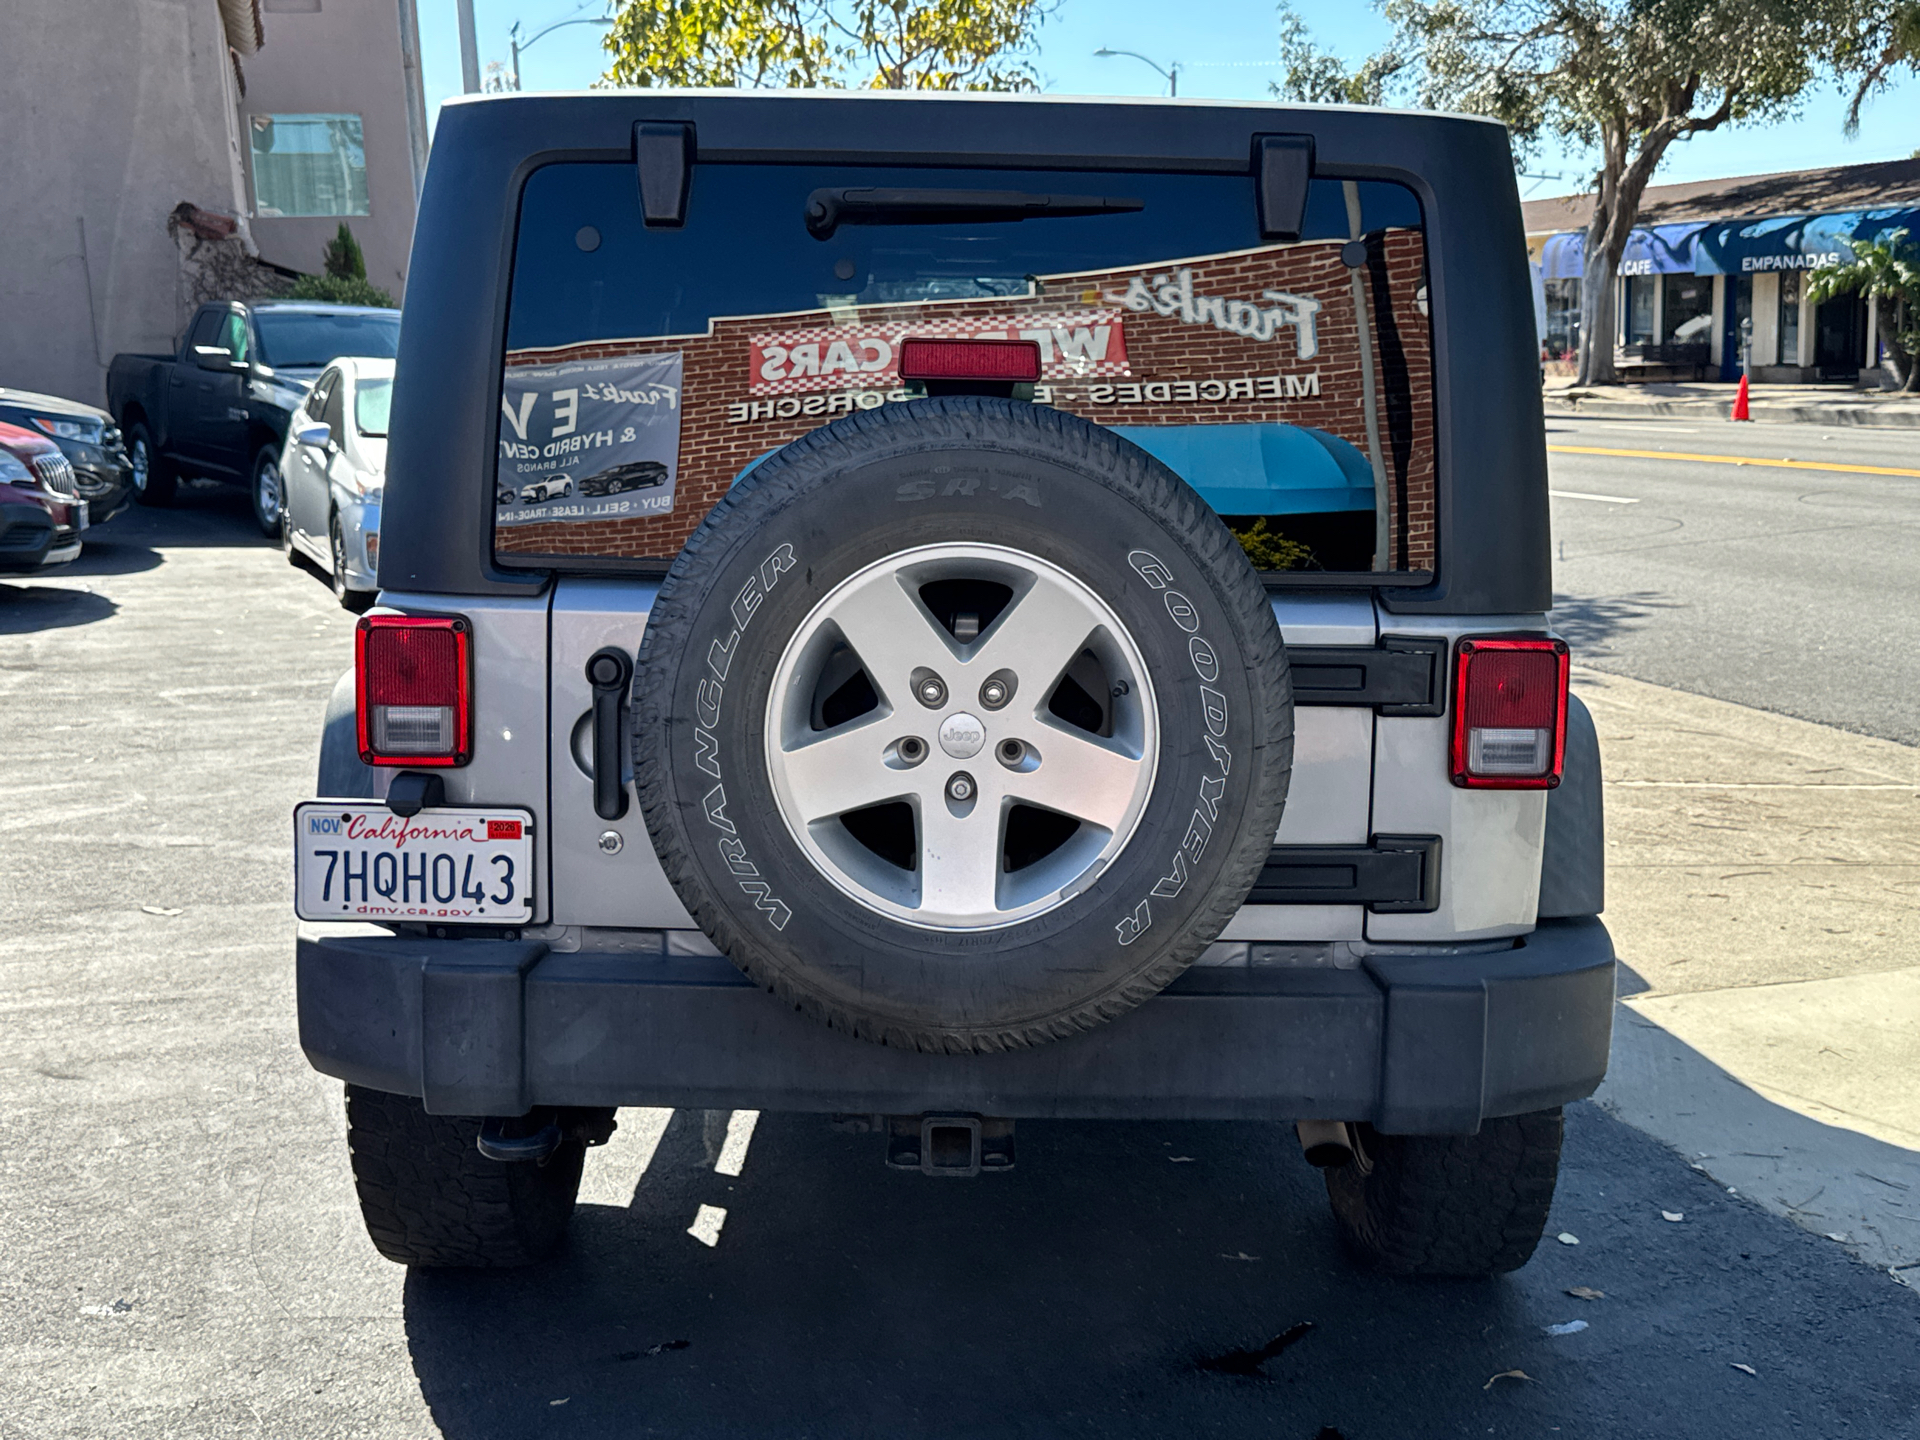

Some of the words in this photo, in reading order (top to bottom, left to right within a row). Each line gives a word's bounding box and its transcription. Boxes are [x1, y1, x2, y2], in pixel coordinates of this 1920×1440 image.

[1624, 258, 1652, 276] CAFE
[1741, 252, 1840, 272] EMPANADAS
[694, 541, 798, 931] WRANGLER
[943, 727, 981, 744] Jeep
[1126, 549, 1231, 945] GOODYEAR
[310, 818, 340, 834] NOV
[347, 814, 490, 849] California
[314, 850, 515, 906] 7HQH043
[356, 904, 475, 917] dmv.ca.gov
